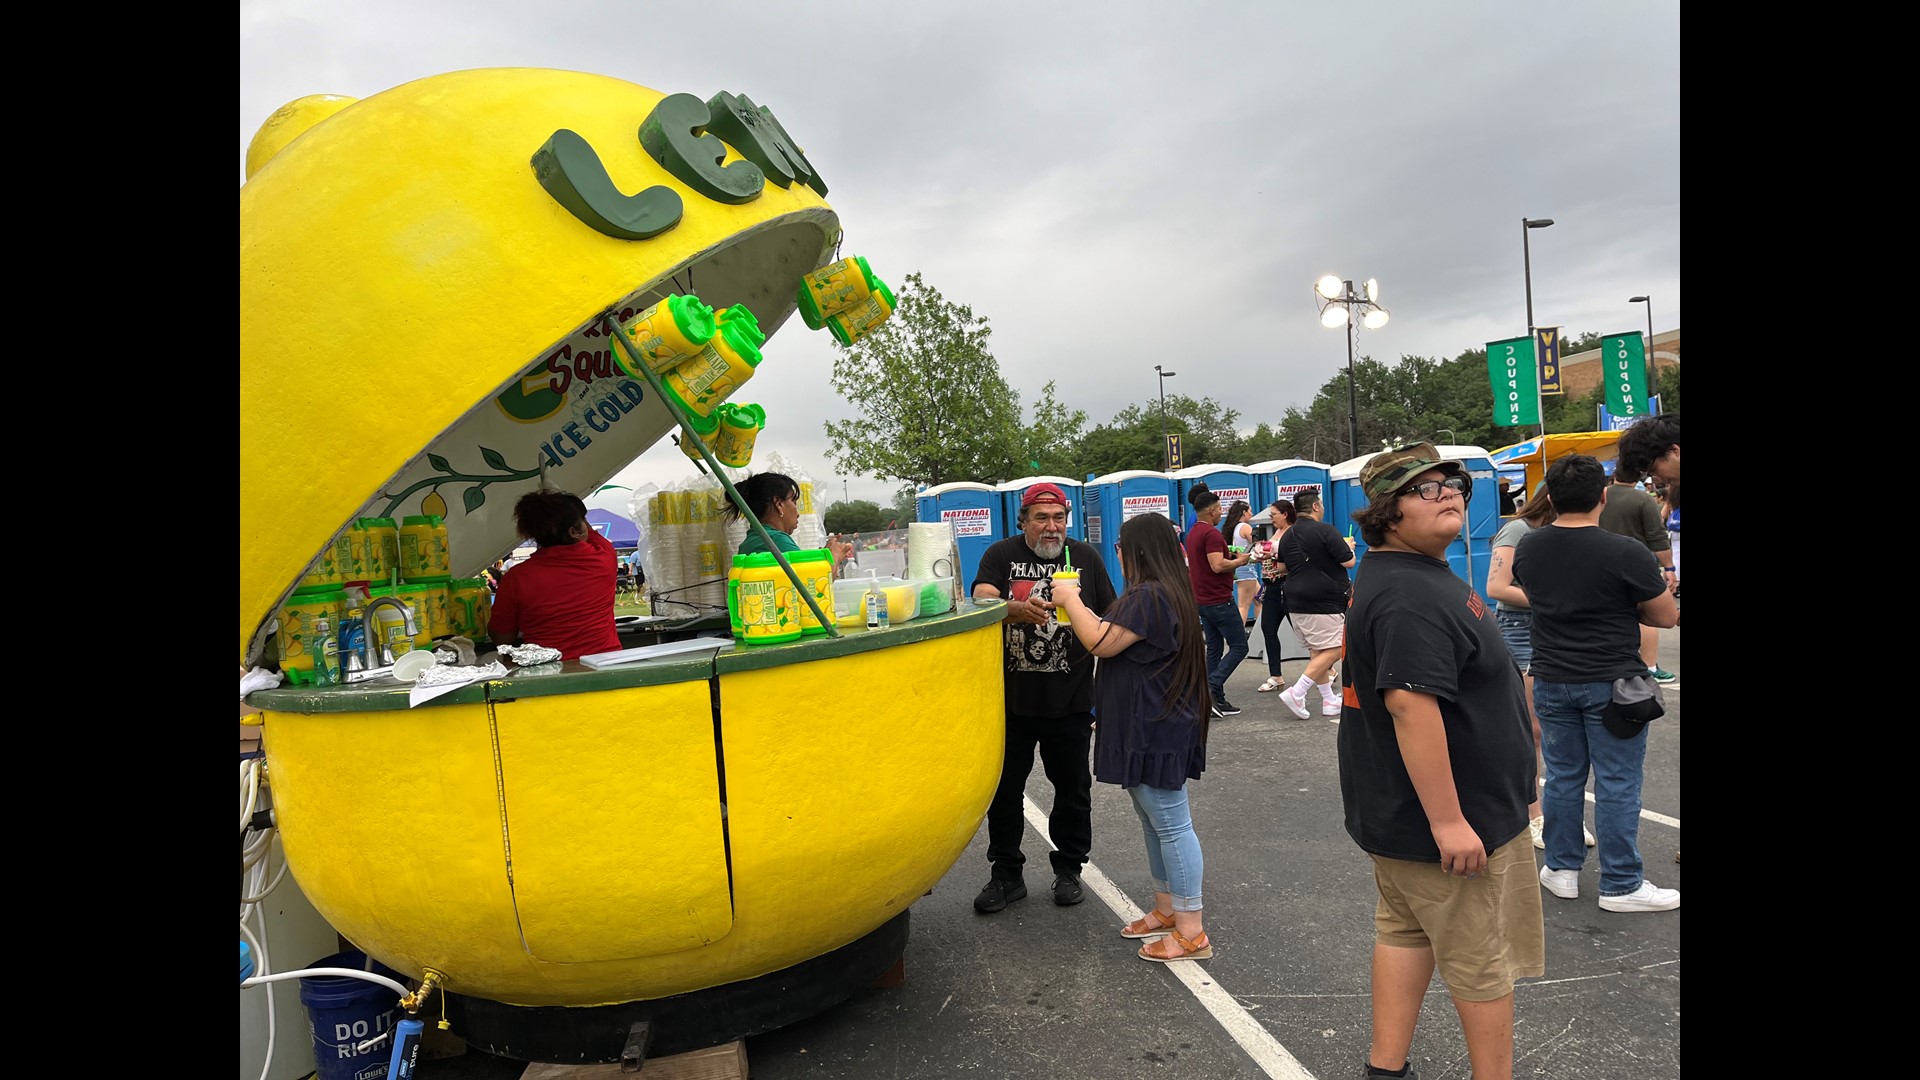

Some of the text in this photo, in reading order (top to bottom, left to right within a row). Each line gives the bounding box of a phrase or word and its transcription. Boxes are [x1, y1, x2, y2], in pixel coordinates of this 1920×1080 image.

[1540, 331, 1555, 380] VIP
[540, 420, 592, 468] ICE
[584, 379, 644, 433] COLD
[1170, 436, 1179, 463] VIP
[1125, 497, 1167, 505] NATIONAL
[1212, 489, 1248, 497] ATIONAL
[943, 509, 989, 518] NATIONAL
[335, 1020, 369, 1041] DO
[376, 1009, 394, 1032] IT
[360, 1065, 389, 1080] LOWE'S
